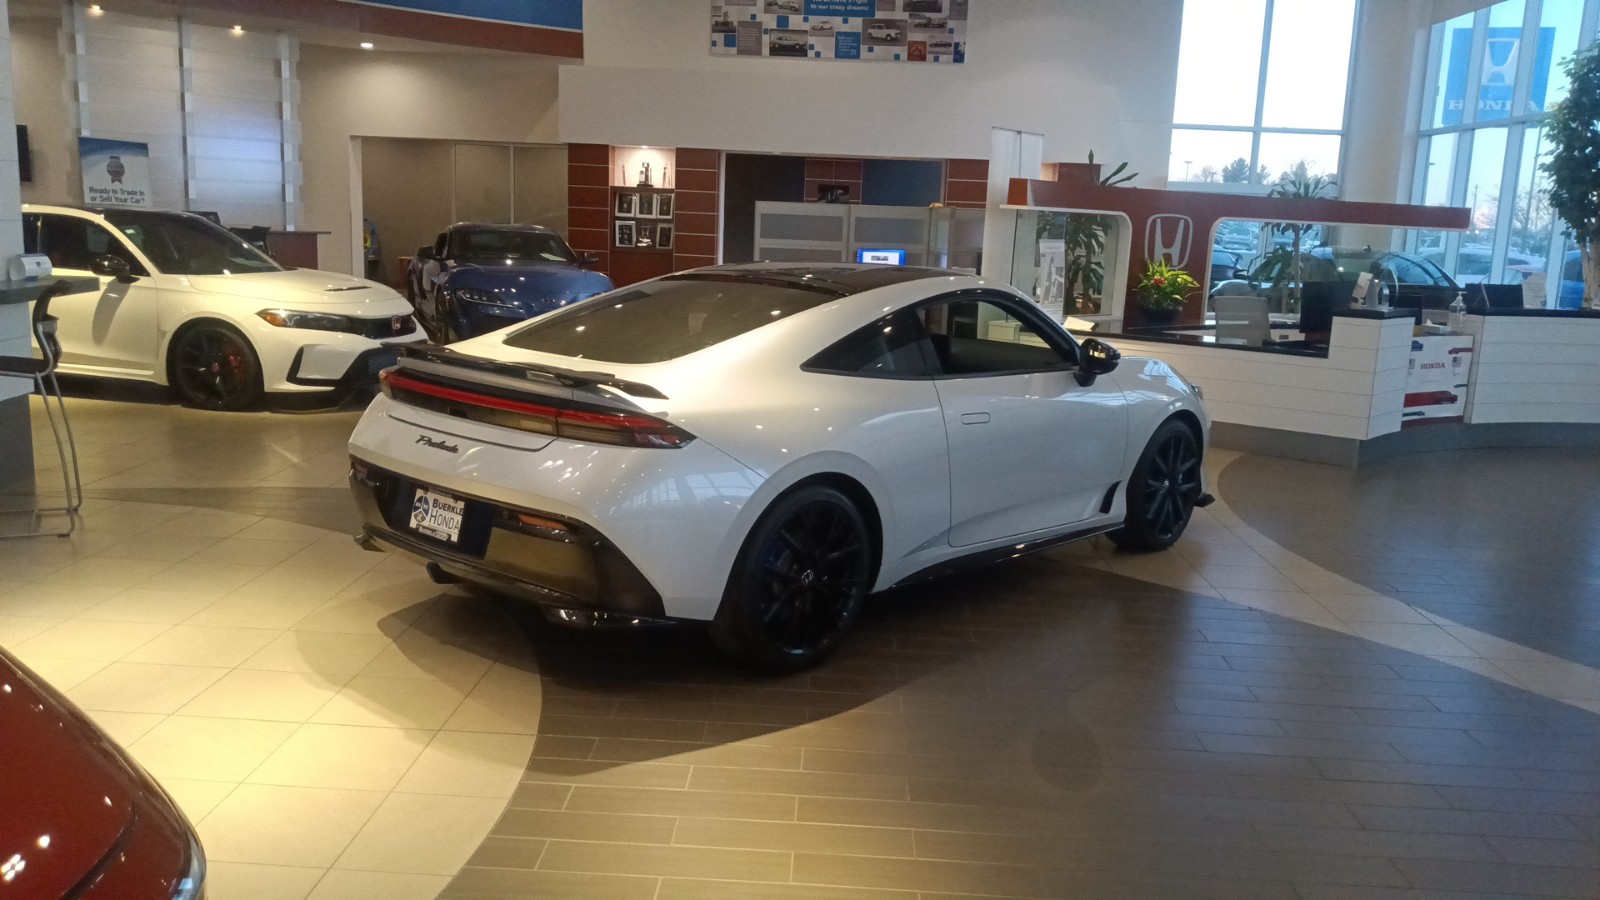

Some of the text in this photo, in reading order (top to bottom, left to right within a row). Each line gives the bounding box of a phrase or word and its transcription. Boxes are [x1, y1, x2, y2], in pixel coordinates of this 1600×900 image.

[1447, 100, 1541, 112] HNA
[89, 186, 111, 195] Ready
[119, 188, 138, 196] Trade
[1420, 362, 1446, 370] HONDA
[415, 434, 459, 454] Prelude
[432, 498, 465, 516] BUERKLE
[429, 508, 460, 531] HONDA
